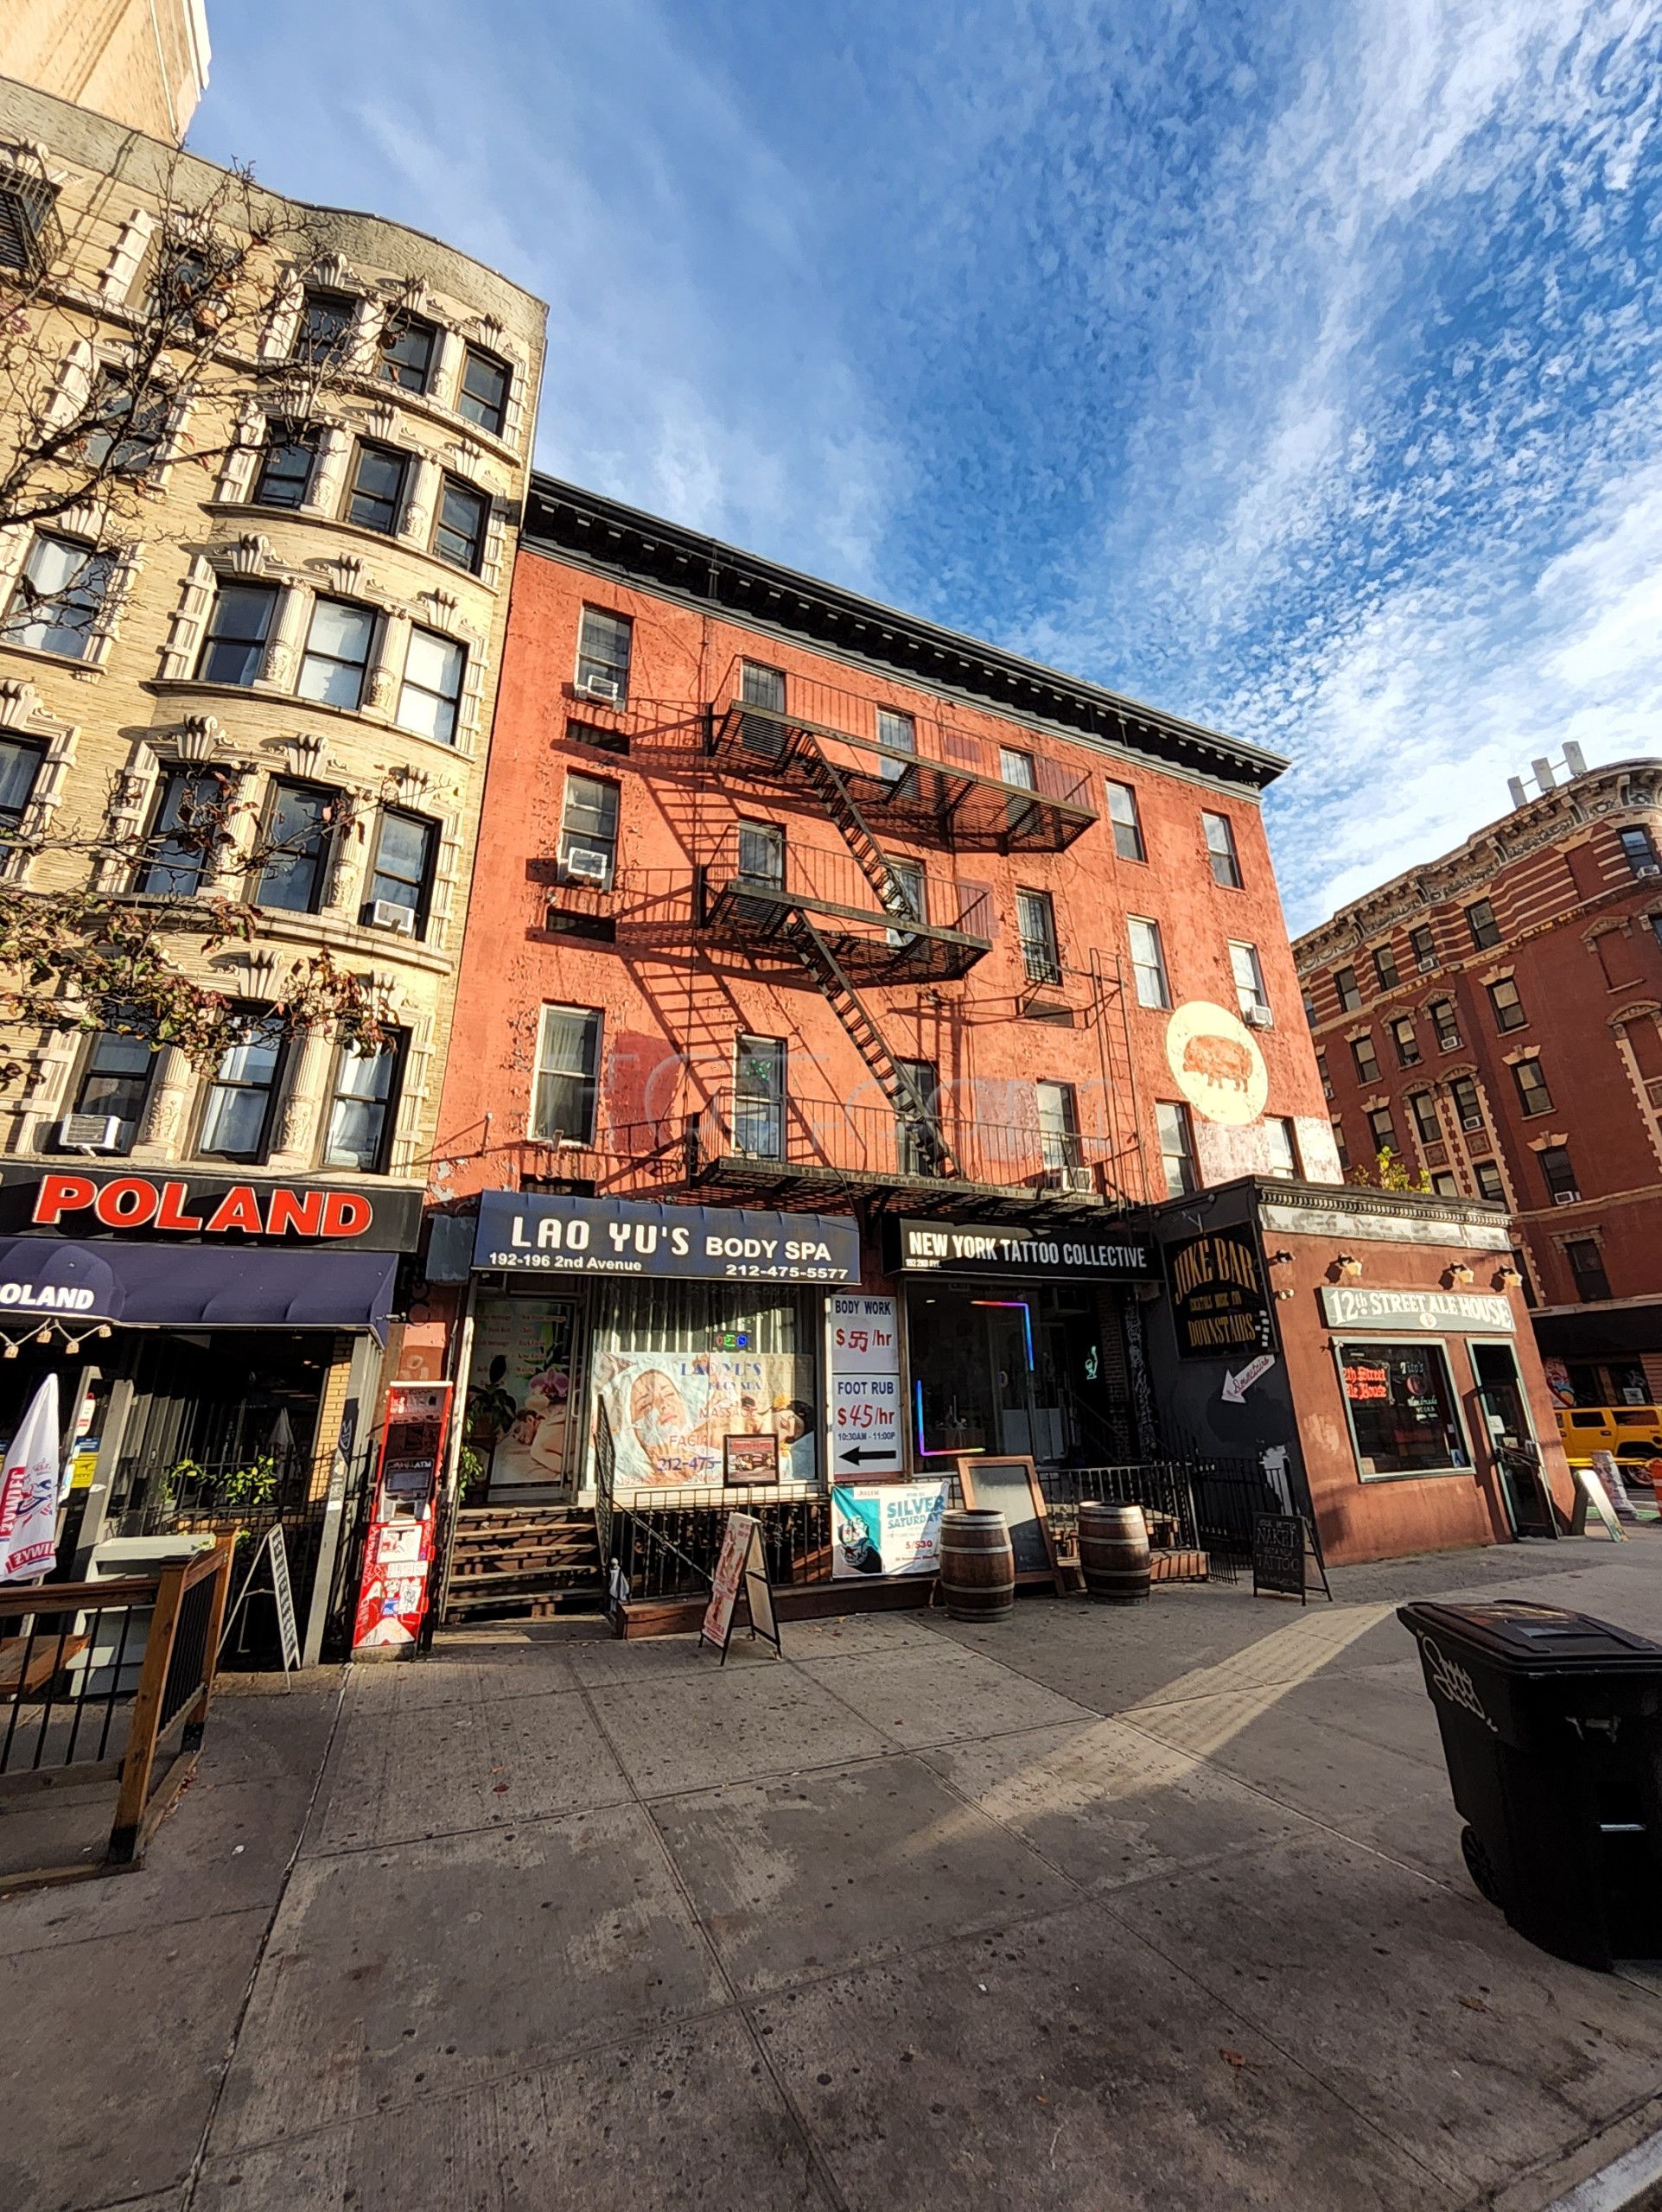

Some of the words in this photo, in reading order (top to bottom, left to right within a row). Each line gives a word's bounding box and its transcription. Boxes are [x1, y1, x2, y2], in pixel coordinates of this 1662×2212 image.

[32, 1174, 373, 1237] POLAND
[511, 1216, 590, 1250] LAO
[608, 1222, 690, 1255] YU'S
[705, 1236, 778, 1259] BODY
[785, 1241, 831, 1261] SPA
[909, 1231, 947, 1257] NEW
[952, 1235, 997, 1261] YORK
[1000, 1239, 1059, 1264] TATTOO
[1063, 1243, 1147, 1268] COLLECTIVE
[489, 1252, 551, 1267] 192-196
[554, 1254, 583, 1268] 2nd
[587, 1257, 642, 1271] Avenue
[1213, 1237, 1258, 1294] BAR
[725, 1264, 848, 1279] 212-475-5577
[0, 1283, 94, 1309] OLAND
[835, 1300, 859, 1314] BODY
[864, 1301, 891, 1315] WORK
[1370, 1293, 1426, 1315] STREET
[1427, 1294, 1459, 1315] ALE
[1459, 1296, 1513, 1330] HOUSE
[1188, 1313, 1256, 1346] DOWNSTAIRS
[1357, 1366, 1386, 1381] Street
[837, 1382, 868, 1395] FOOT
[871, 1382, 894, 1395] RUB
[1359, 1382, 1386, 1400] House
[698, 1406, 758, 1418] MASSAGE
[670, 1434, 715, 1447] FACIAL
[414, 1460, 431, 1469] ATM
[659, 1457, 722, 1471] 212-475-
[887, 1495, 946, 1518] SILVER
